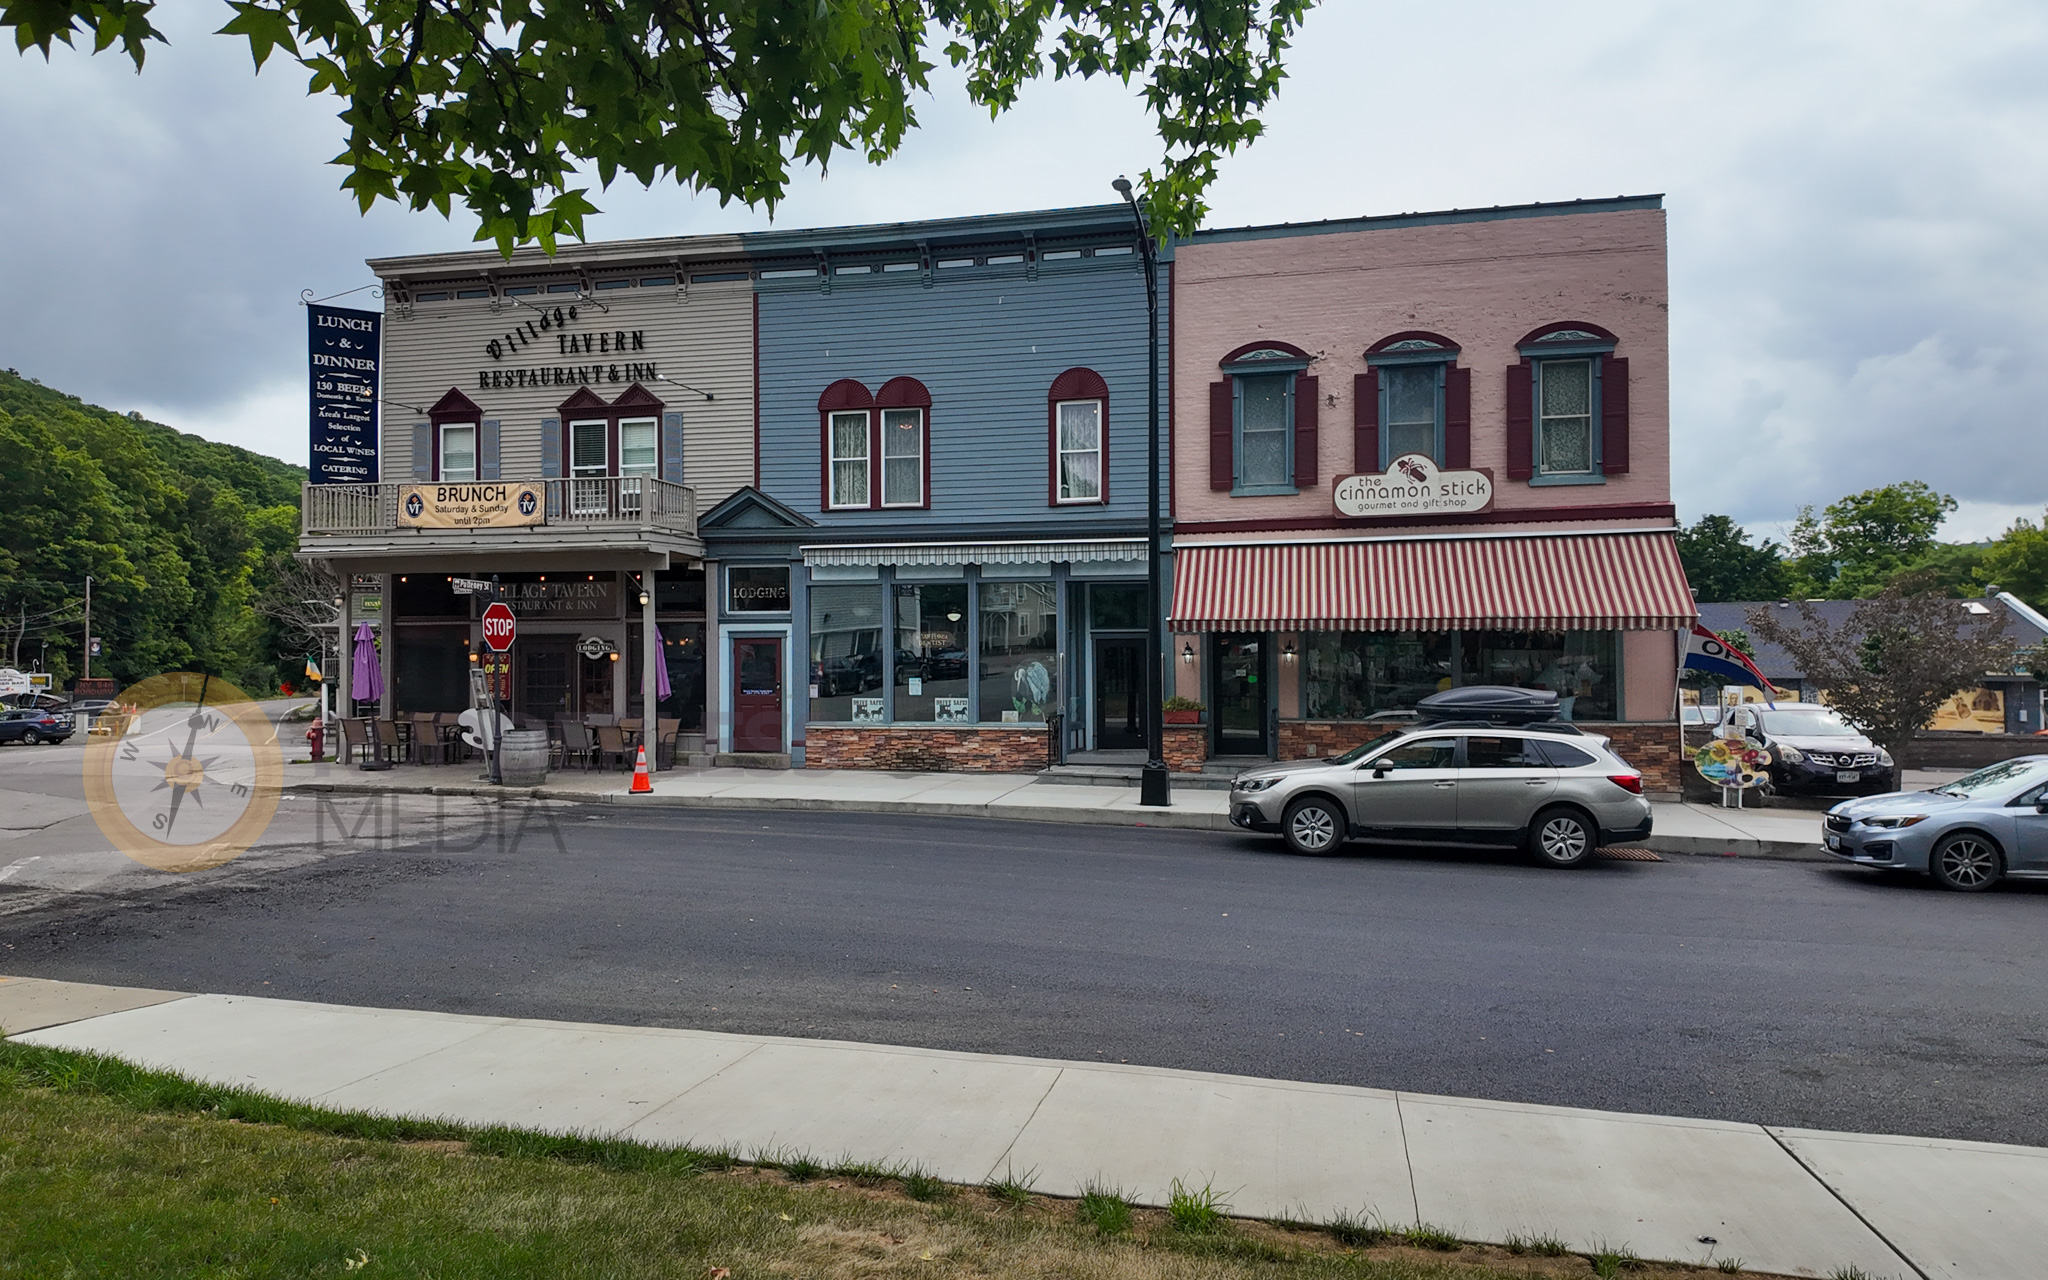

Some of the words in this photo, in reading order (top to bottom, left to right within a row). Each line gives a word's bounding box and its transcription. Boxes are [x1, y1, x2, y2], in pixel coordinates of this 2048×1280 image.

[317, 315, 373, 332] LUNCH
[485, 305, 578, 359] Village
[339, 337, 352, 349] &
[557, 330, 644, 354] TAVERN
[313, 354, 376, 371] DINNER
[479, 365, 603, 388] RESTAURANT
[607, 363, 620, 382] &
[625, 362, 657, 381] INN
[316, 381, 333, 391] 130
[337, 382, 373, 396] BEERS
[316, 392, 344, 400] Domestic
[343, 412, 371, 422] Largest
[328, 422, 361, 432] Selection
[340, 435, 350, 443] of
[314, 444, 346, 454] LOCAL
[346, 446, 376, 456] WINES
[321, 464, 368, 475] CATERING
[1359, 476, 1382, 487] the
[437, 486, 507, 502] BRUNCH
[1340, 485, 1431, 500] cinnamon
[1440, 478, 1486, 497] stick
[434, 504, 469, 515] Saturday
[470, 505, 477, 513] &
[478, 504, 509, 514] Sunday
[1357, 501, 1397, 512] gourmet
[1400, 499, 1419, 508] and
[1422, 498, 1440, 509] gift
[1443, 498, 1467, 508] shop
[454, 517, 472, 525] until
[472, 517, 490, 526] 2pm
[500, 583, 548, 599] ILLAGE
[551, 583, 608, 598] TAVERN
[733, 587, 786, 599] LODGING
[565, 601, 574, 610] &
[577, 601, 598, 610] INN
[485, 617, 514, 637] STOP
